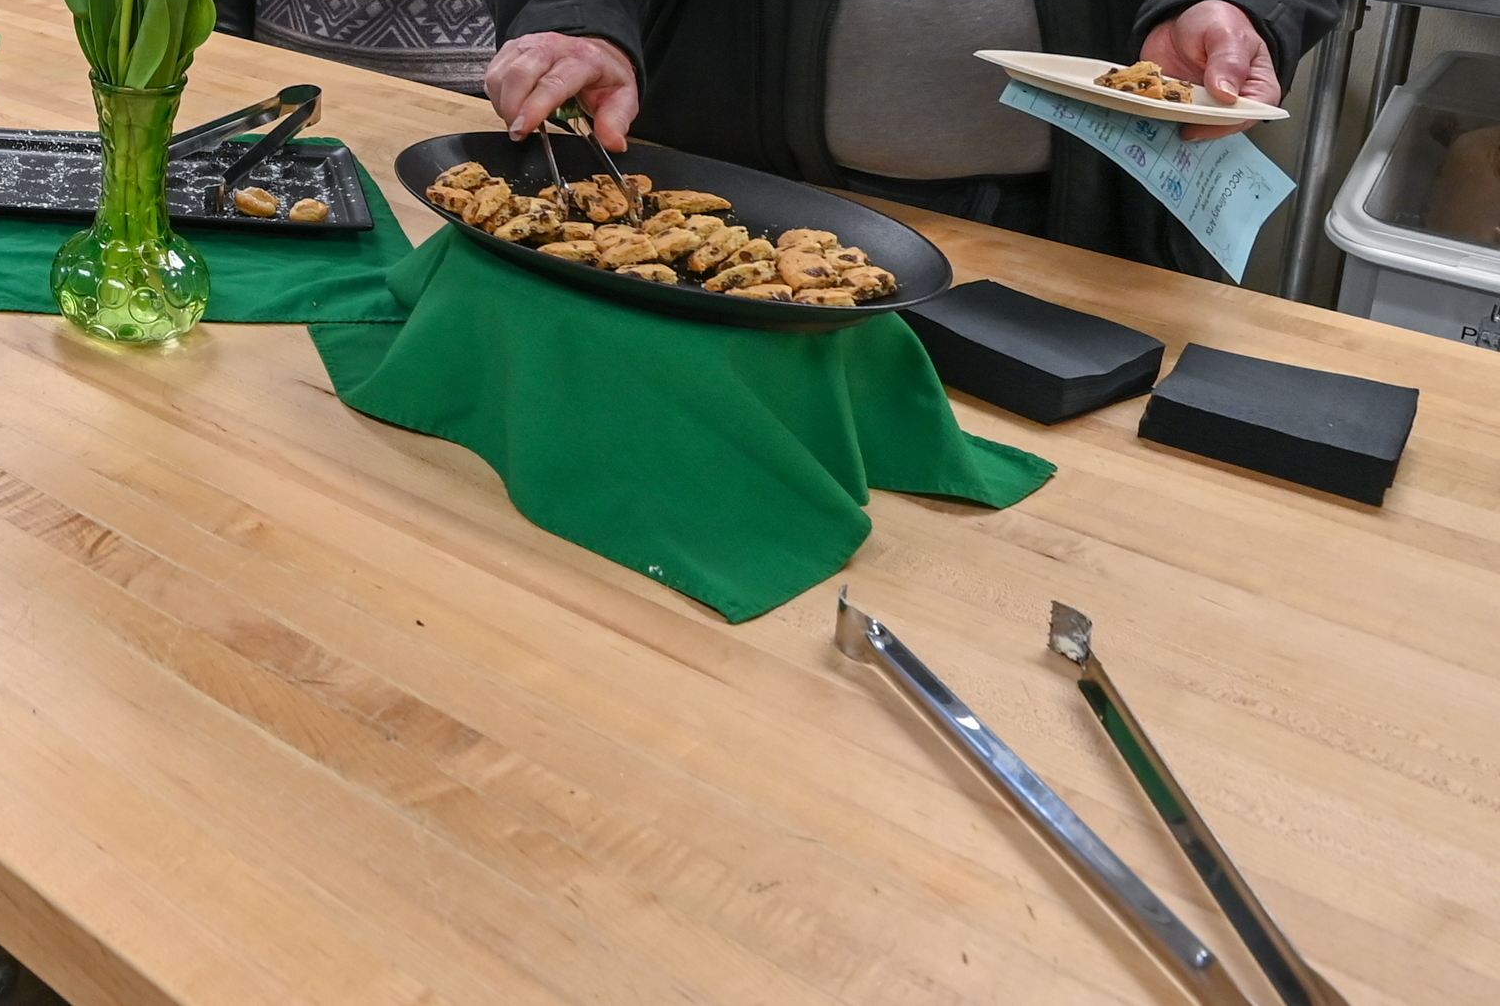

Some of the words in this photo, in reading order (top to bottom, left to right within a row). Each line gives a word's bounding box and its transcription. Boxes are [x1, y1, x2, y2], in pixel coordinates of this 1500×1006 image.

[1228, 168, 1244, 189] HCC
[1211, 186, 1233, 220] Culinary
[1205, 218, 1217, 236] Arts
